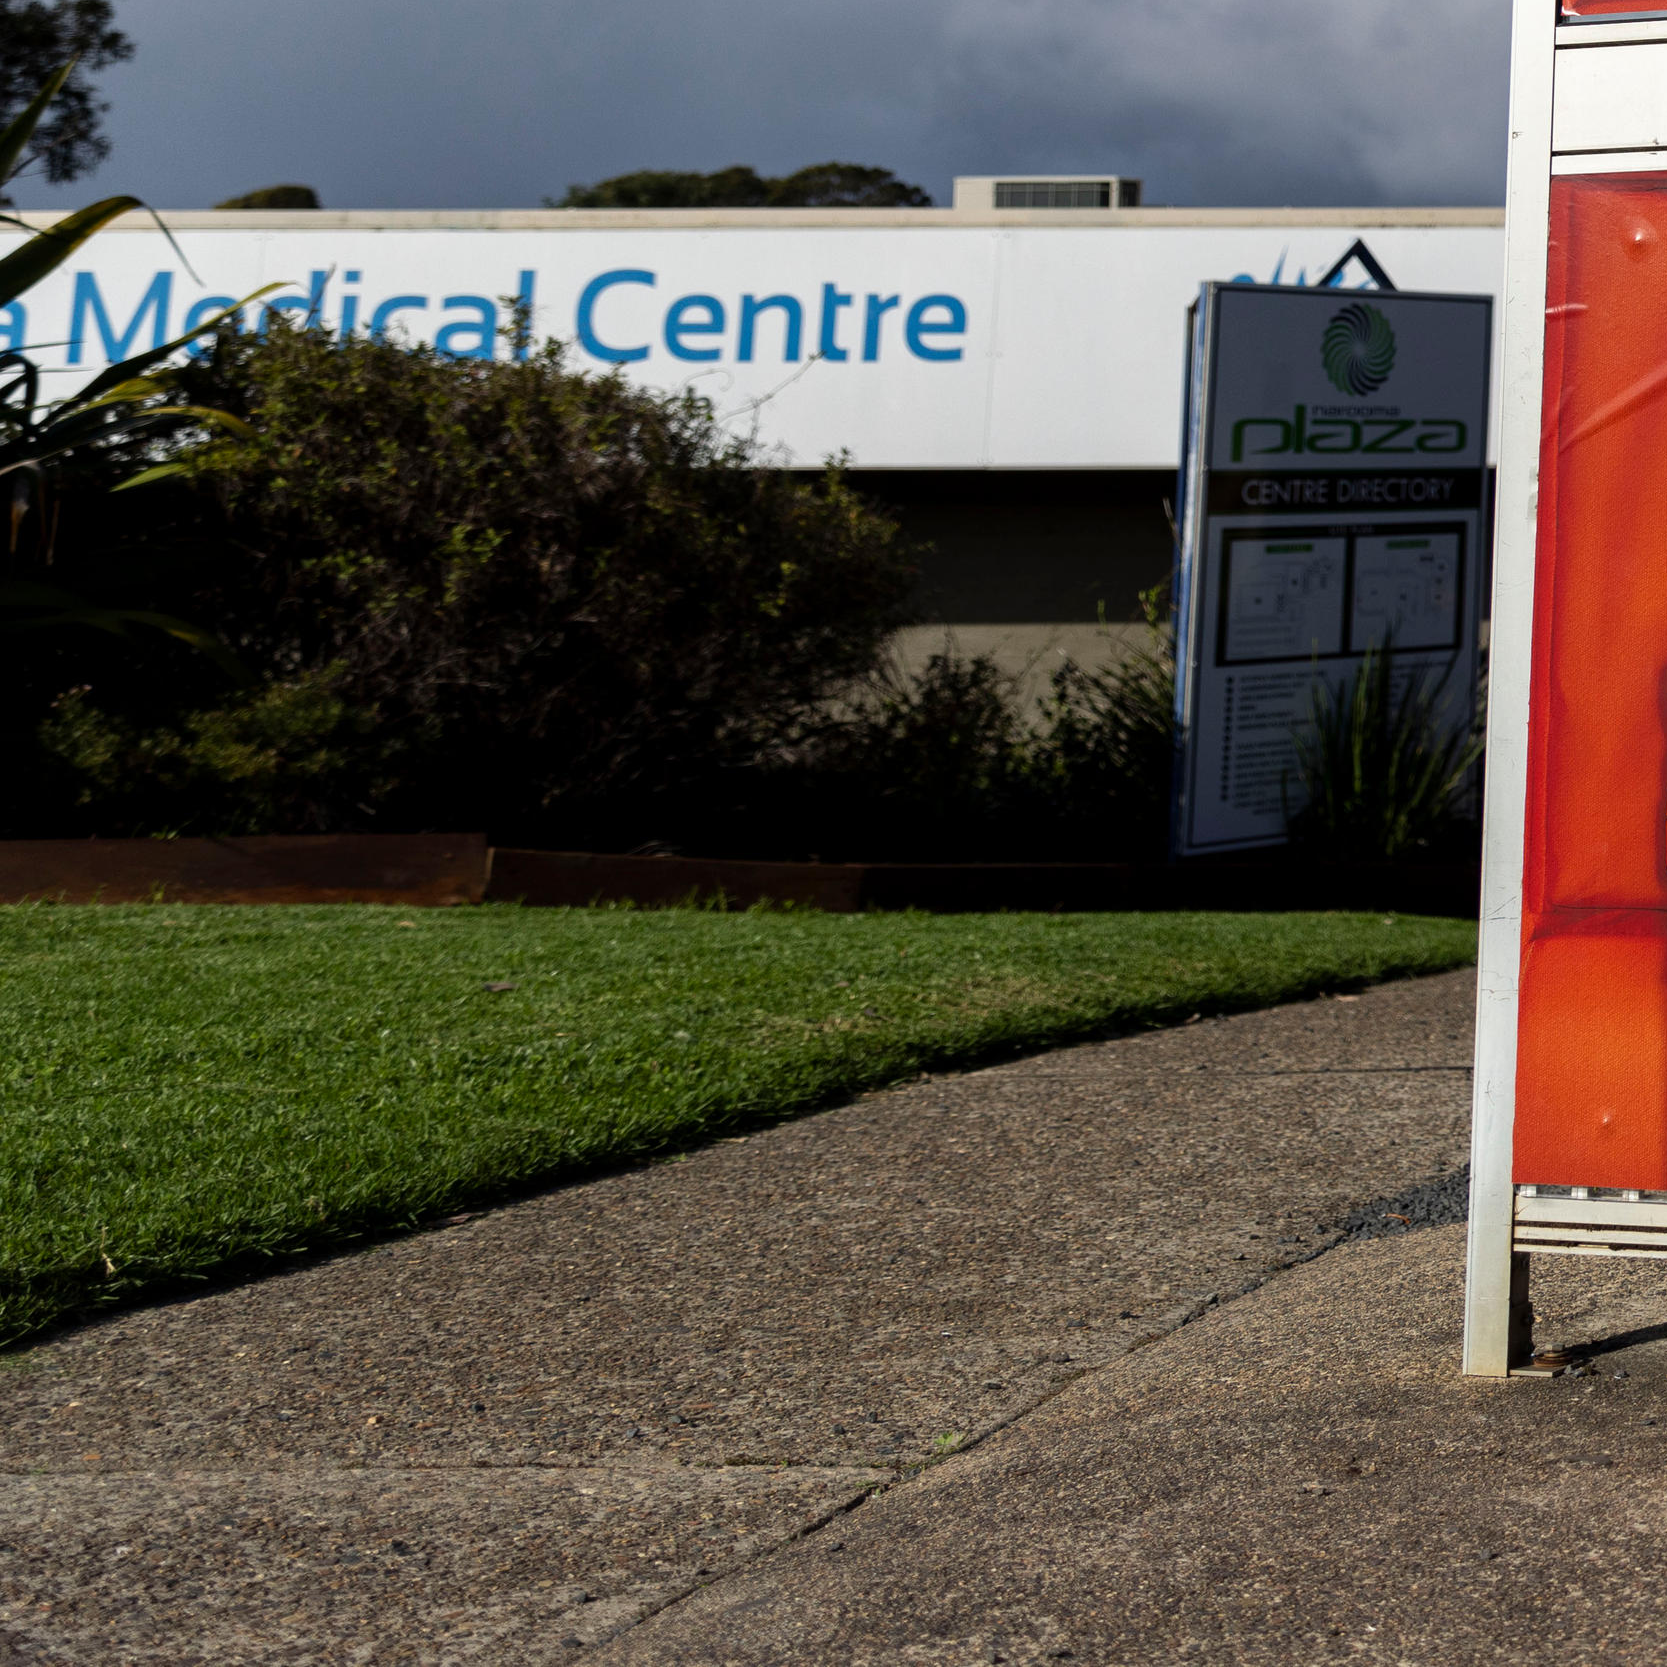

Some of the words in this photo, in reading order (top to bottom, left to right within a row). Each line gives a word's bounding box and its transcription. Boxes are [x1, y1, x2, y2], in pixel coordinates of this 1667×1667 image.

[575, 268, 968, 363] Centre
[1232, 405, 1467, 463] plaza
[1241, 476, 1330, 507] CENTRE
[1336, 475, 1456, 504] DIRECTORY
